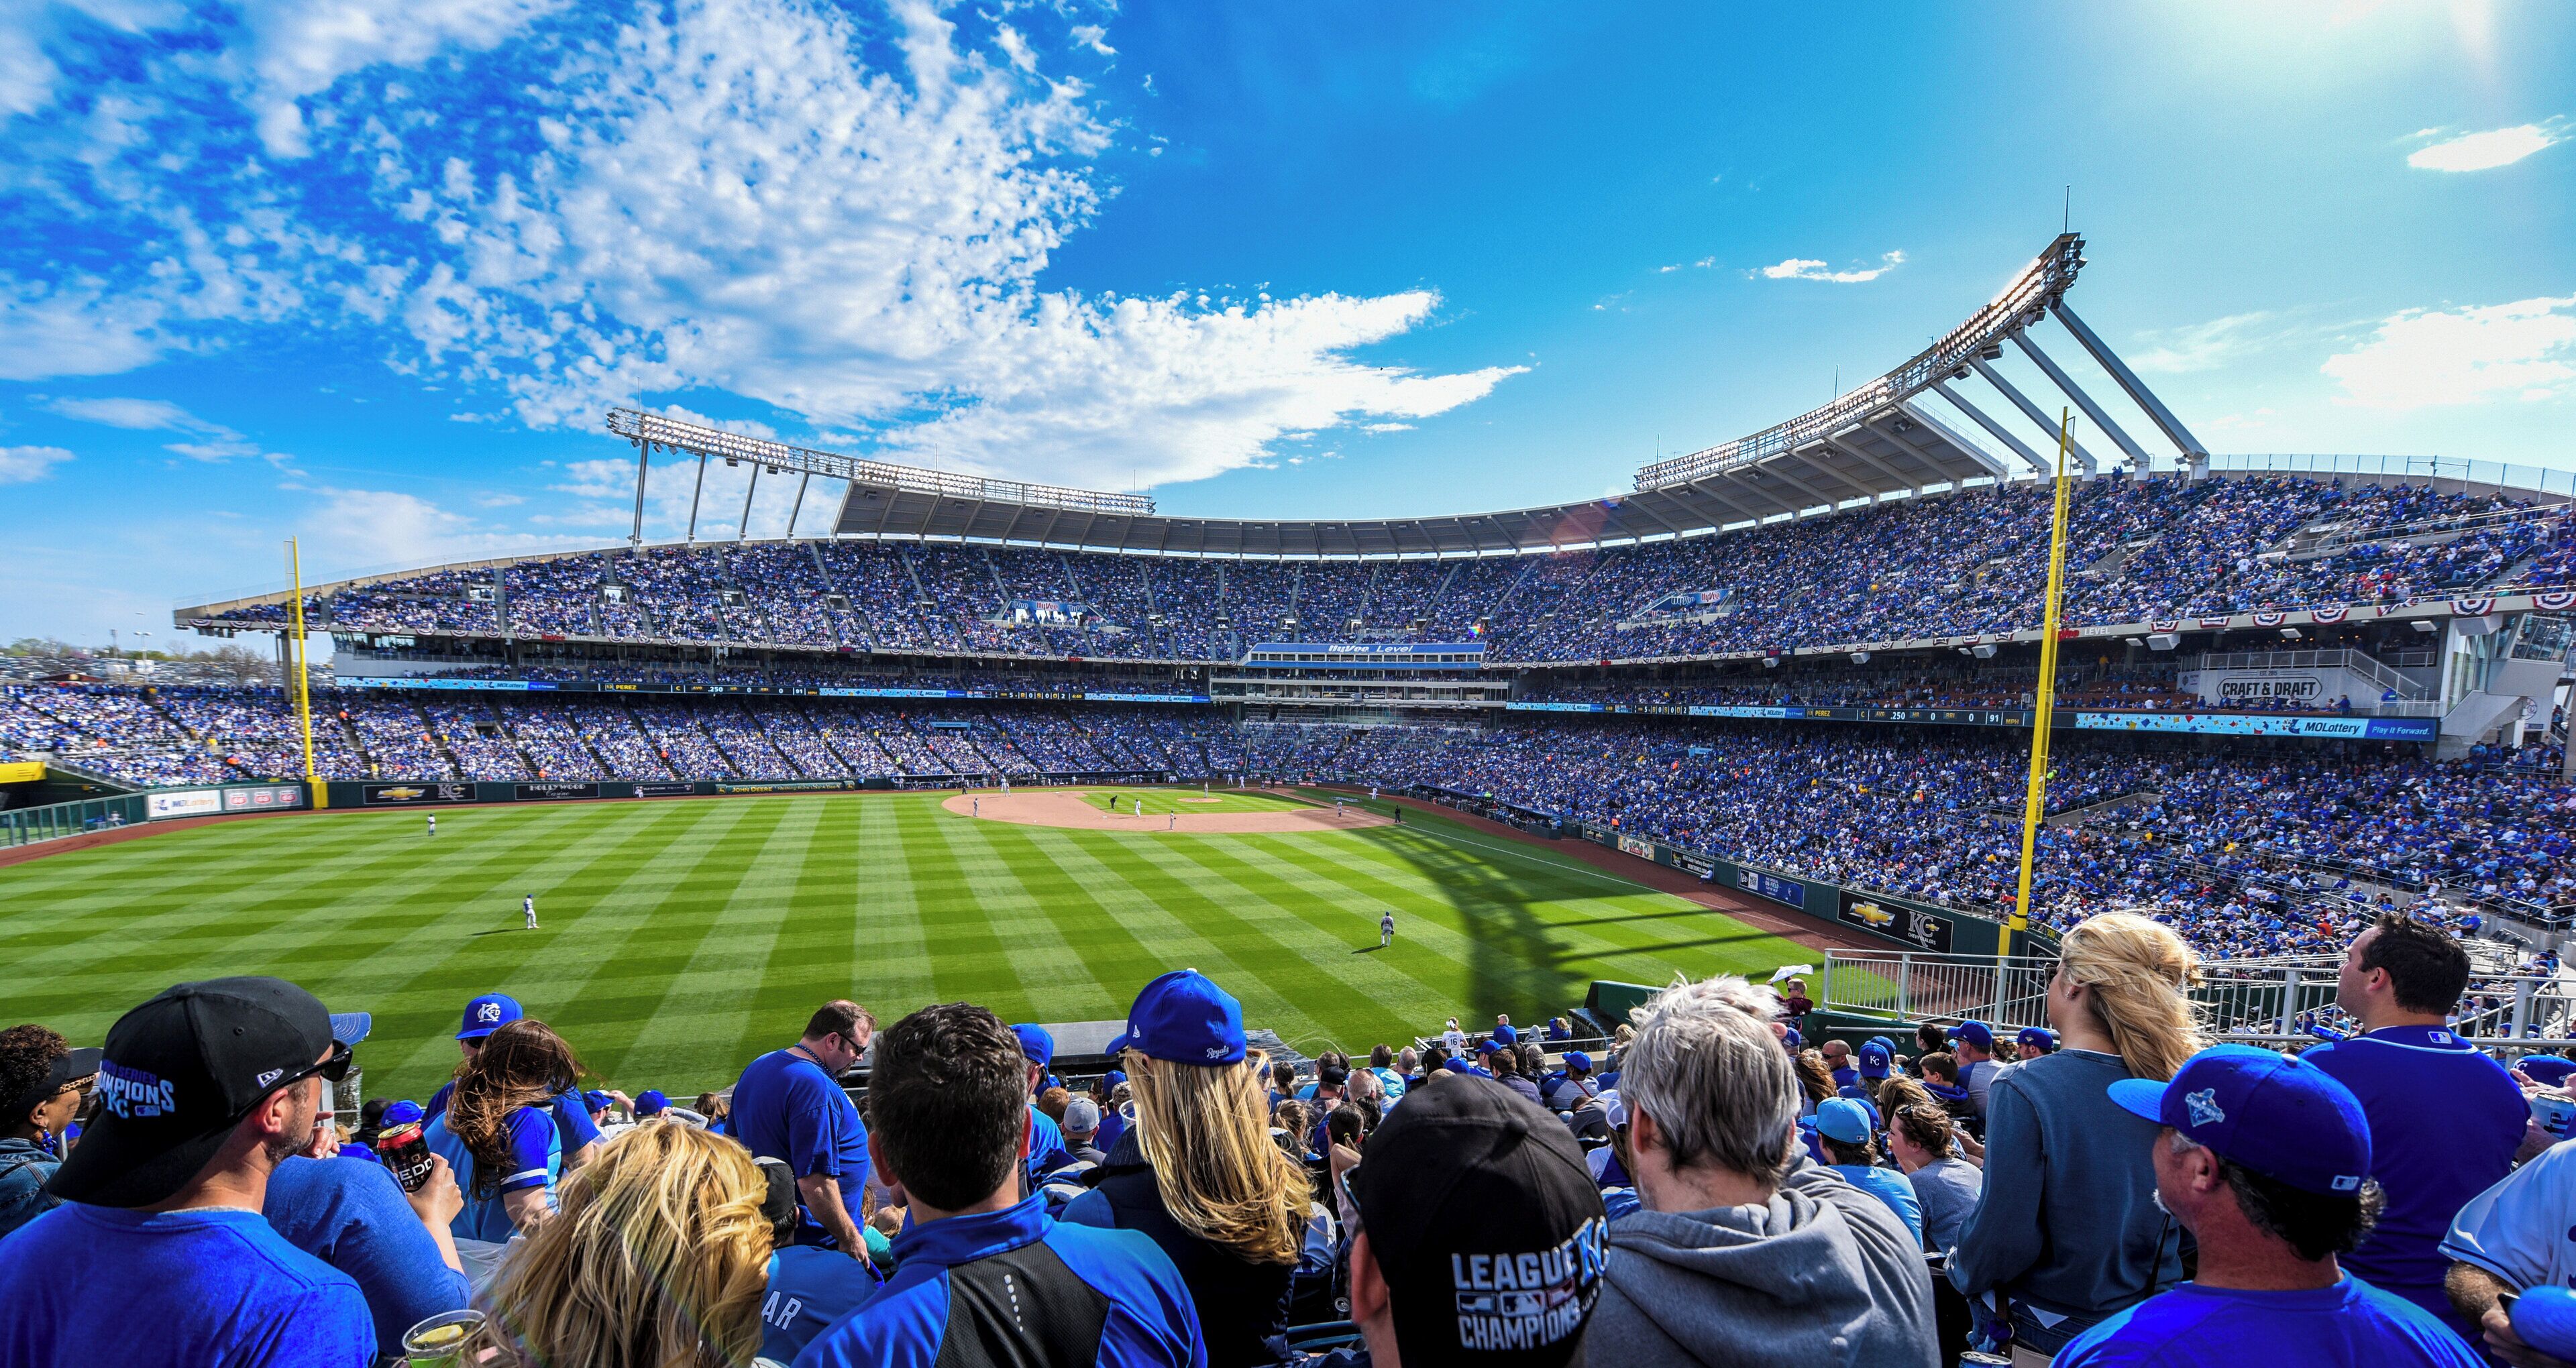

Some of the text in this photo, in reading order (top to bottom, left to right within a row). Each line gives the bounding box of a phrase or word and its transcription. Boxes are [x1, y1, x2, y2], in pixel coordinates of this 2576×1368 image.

[1701, 592, 1720, 602] HyVee
[1036, 601, 1059, 610] HyVee
[2084, 627, 2110, 636] LEVEL
[1328, 644, 1369, 653] HyVee
[2222, 681, 2316, 695] CRAFT & DRAFT
[1890, 711, 1906, 720] .250
[1930, 712, 1935, 721] 0
[1968, 713, 1974, 722] 0
[1990, 714, 1999, 722] 91
[2304, 722, 2361, 735] MOLottery
[2371, 726, 2388, 734] Play
[2396, 727, 2430, 736] Forward.
[172, 799, 215, 807] MOLottery
[1908, 911, 1934, 948] KC
[2046, 928, 2055, 938] 330
[1450, 1038, 1458, 1046] 16
[1206, 1045, 1230, 1059] Royals
[1870, 1055, 1880, 1066] KC
[119, 1066, 157, 1085] SERIES
[107, 1090, 129, 1119] KC
[397, 1158, 433, 1181] EDD
[404, 1175, 425, 1187] PPLE
[1572, 1215, 1610, 1288] KC
[1451, 1238, 1578, 1291] LEAGUE
[1458, 1295, 1580, 1351] CHAMPIONS
